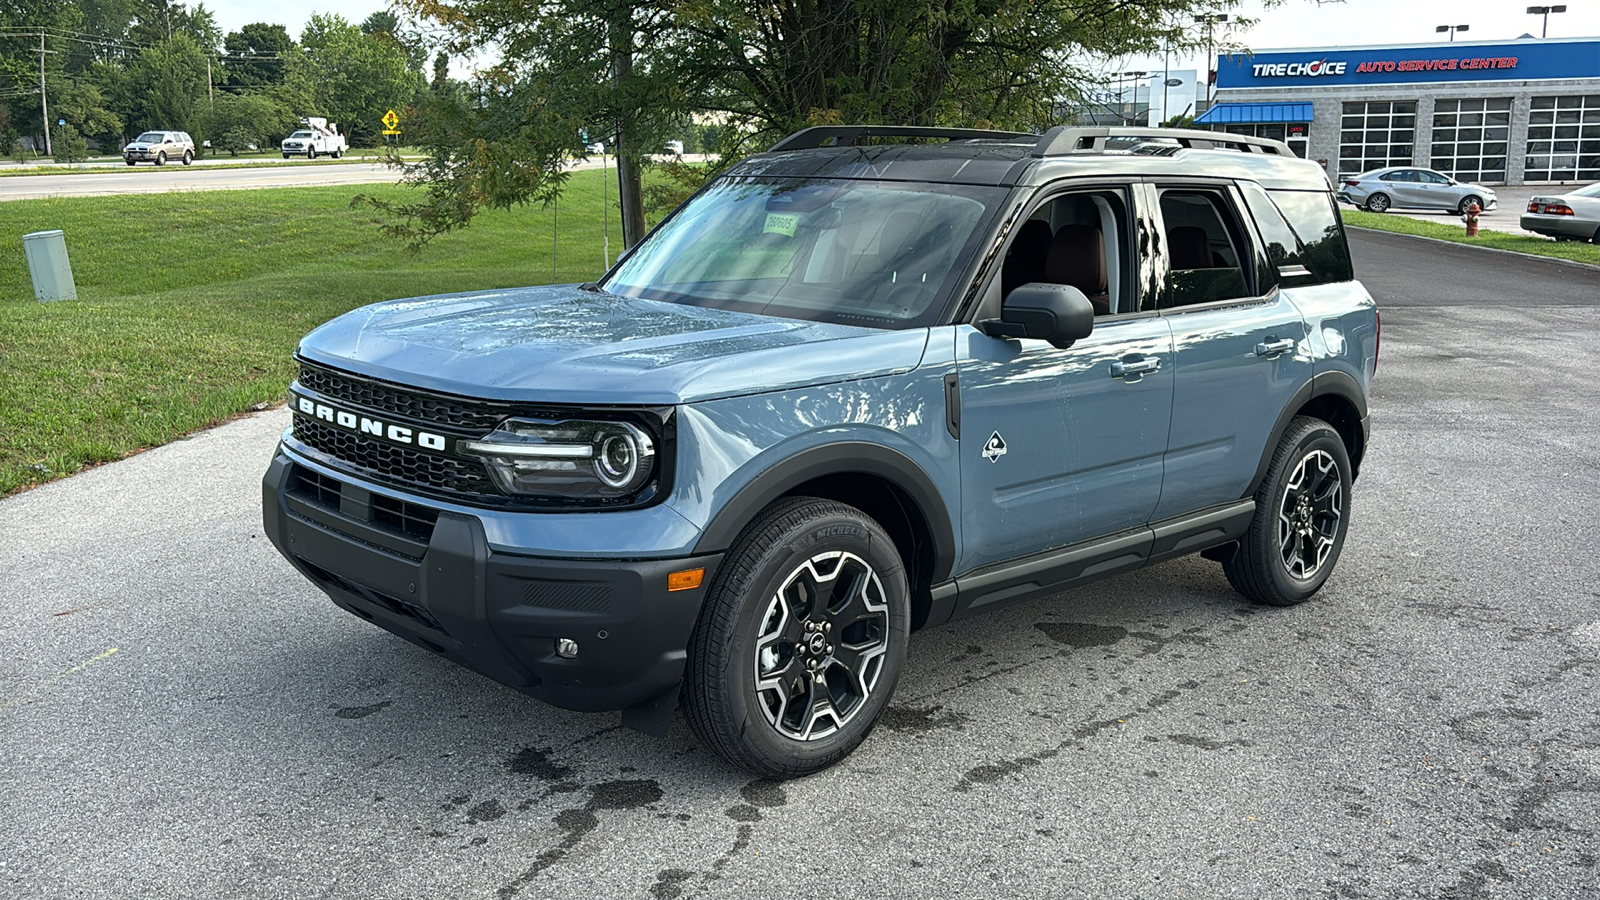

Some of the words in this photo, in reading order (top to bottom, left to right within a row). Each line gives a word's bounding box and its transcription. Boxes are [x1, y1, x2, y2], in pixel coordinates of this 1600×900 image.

[1355, 61, 1395, 73] AUTO
[1397, 58, 1458, 71] SERVICE
[1459, 56, 1519, 69] CENTER
[767, 217, 793, 229] 260605
[298, 397, 446, 451] BRONCO
